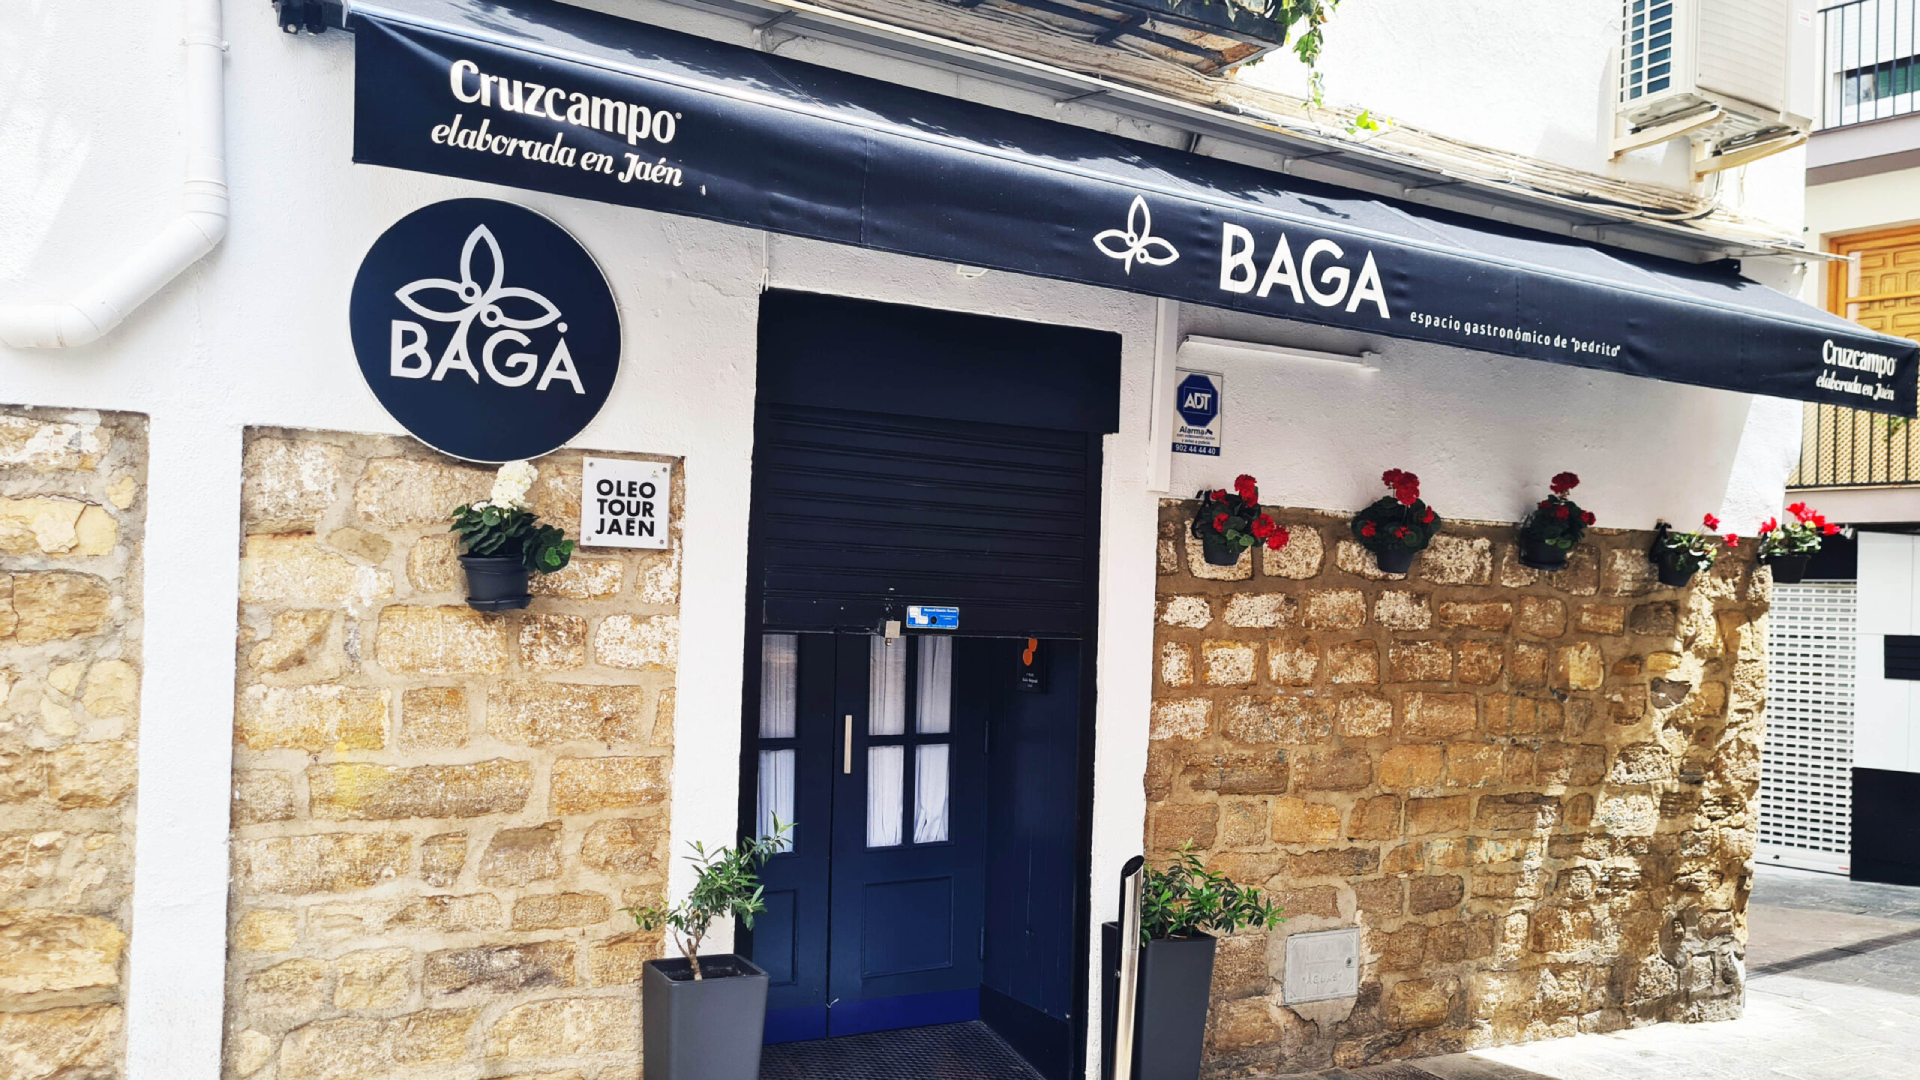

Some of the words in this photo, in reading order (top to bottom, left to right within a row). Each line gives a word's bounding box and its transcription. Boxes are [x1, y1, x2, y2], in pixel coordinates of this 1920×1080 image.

[449, 59, 679, 145] Cruzcampo
[430, 114, 577, 168] elaborada
[580, 153, 614, 175] en
[617, 152, 683, 187] Jaén
[1219, 221, 1391, 319] BAGA
[1410, 310, 1461, 332] espacio
[1464, 321, 1551, 346] gastronómico
[1553, 334, 1568, 349] de
[1822, 339, 1897, 379] Cruzcampo
[1815, 369, 1862, 395] elaborada
[1862, 384, 1873, 397] en
[1183, 392, 1212, 411] ADT
[1179, 425, 1205, 435] Alarma
[1175, 444, 1188, 453] 902
[1189, 445, 1197, 453] 44
[1198, 446, 1207, 454] 44
[1207, 447, 1216, 455] 40
[596, 479, 656, 499] OLEO
[596, 498, 655, 518] TOUR
